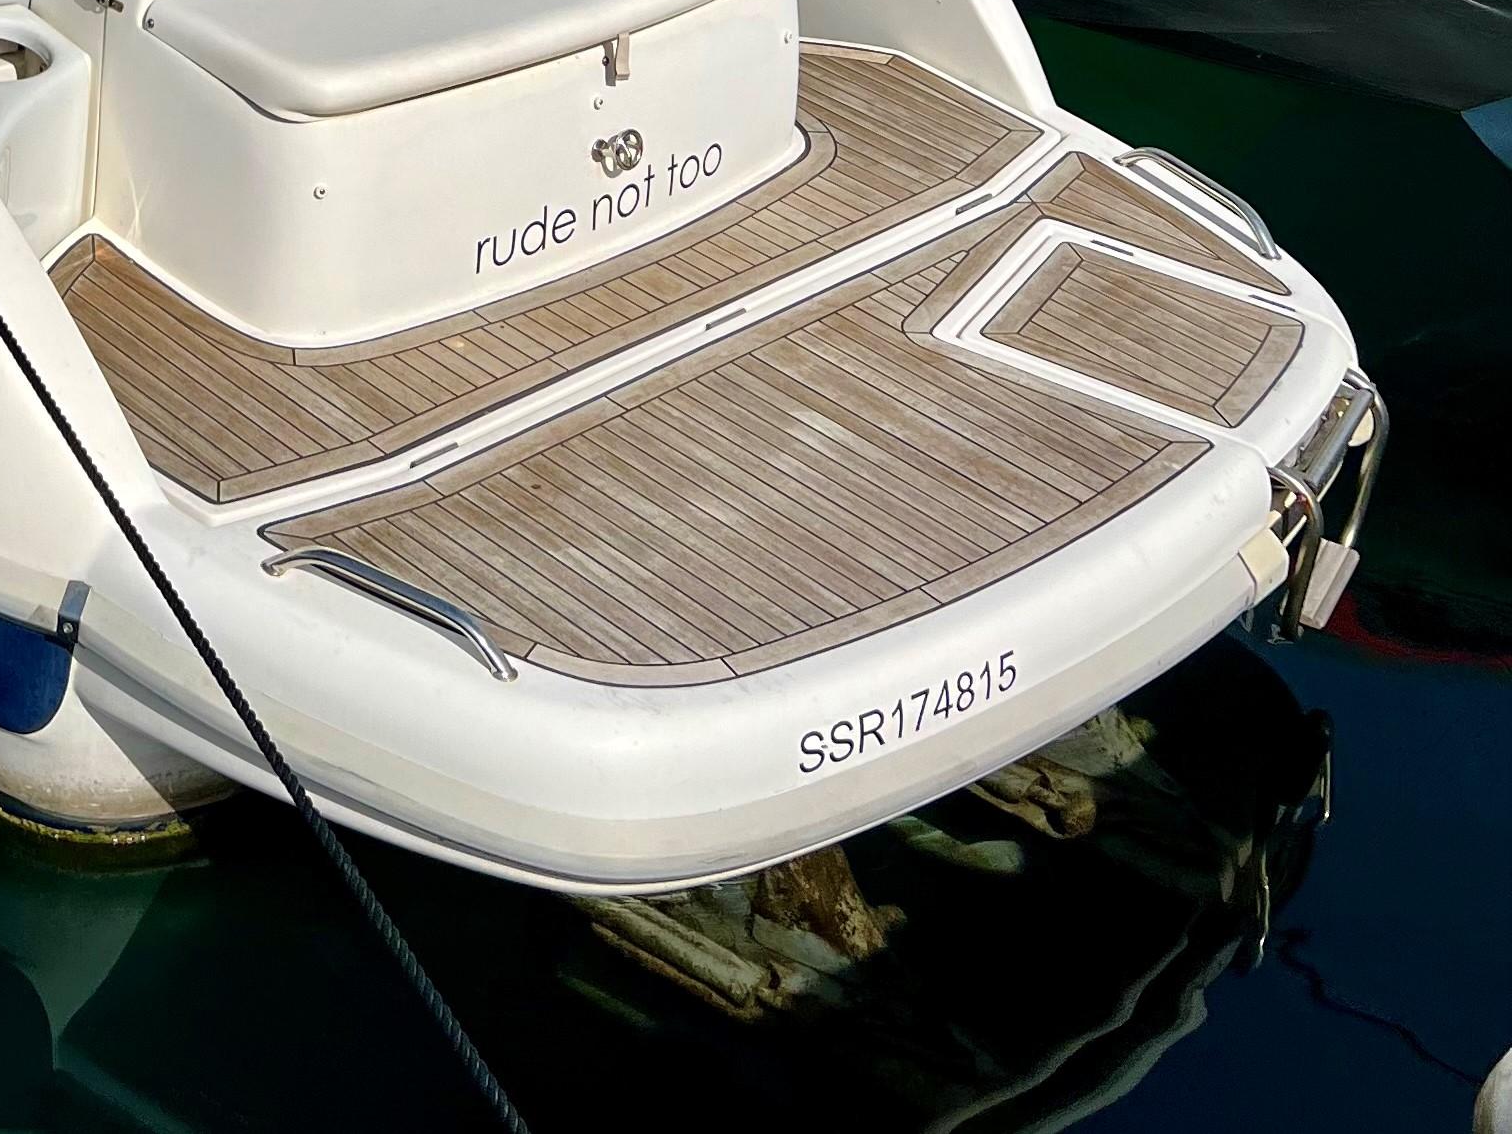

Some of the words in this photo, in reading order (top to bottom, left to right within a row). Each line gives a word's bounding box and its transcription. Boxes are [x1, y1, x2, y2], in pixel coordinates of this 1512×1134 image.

[475, 204, 577, 274] rude
[591, 164, 655, 231] not
[667, 142, 723, 197] too
[799, 649, 1017, 773] SSR174815
